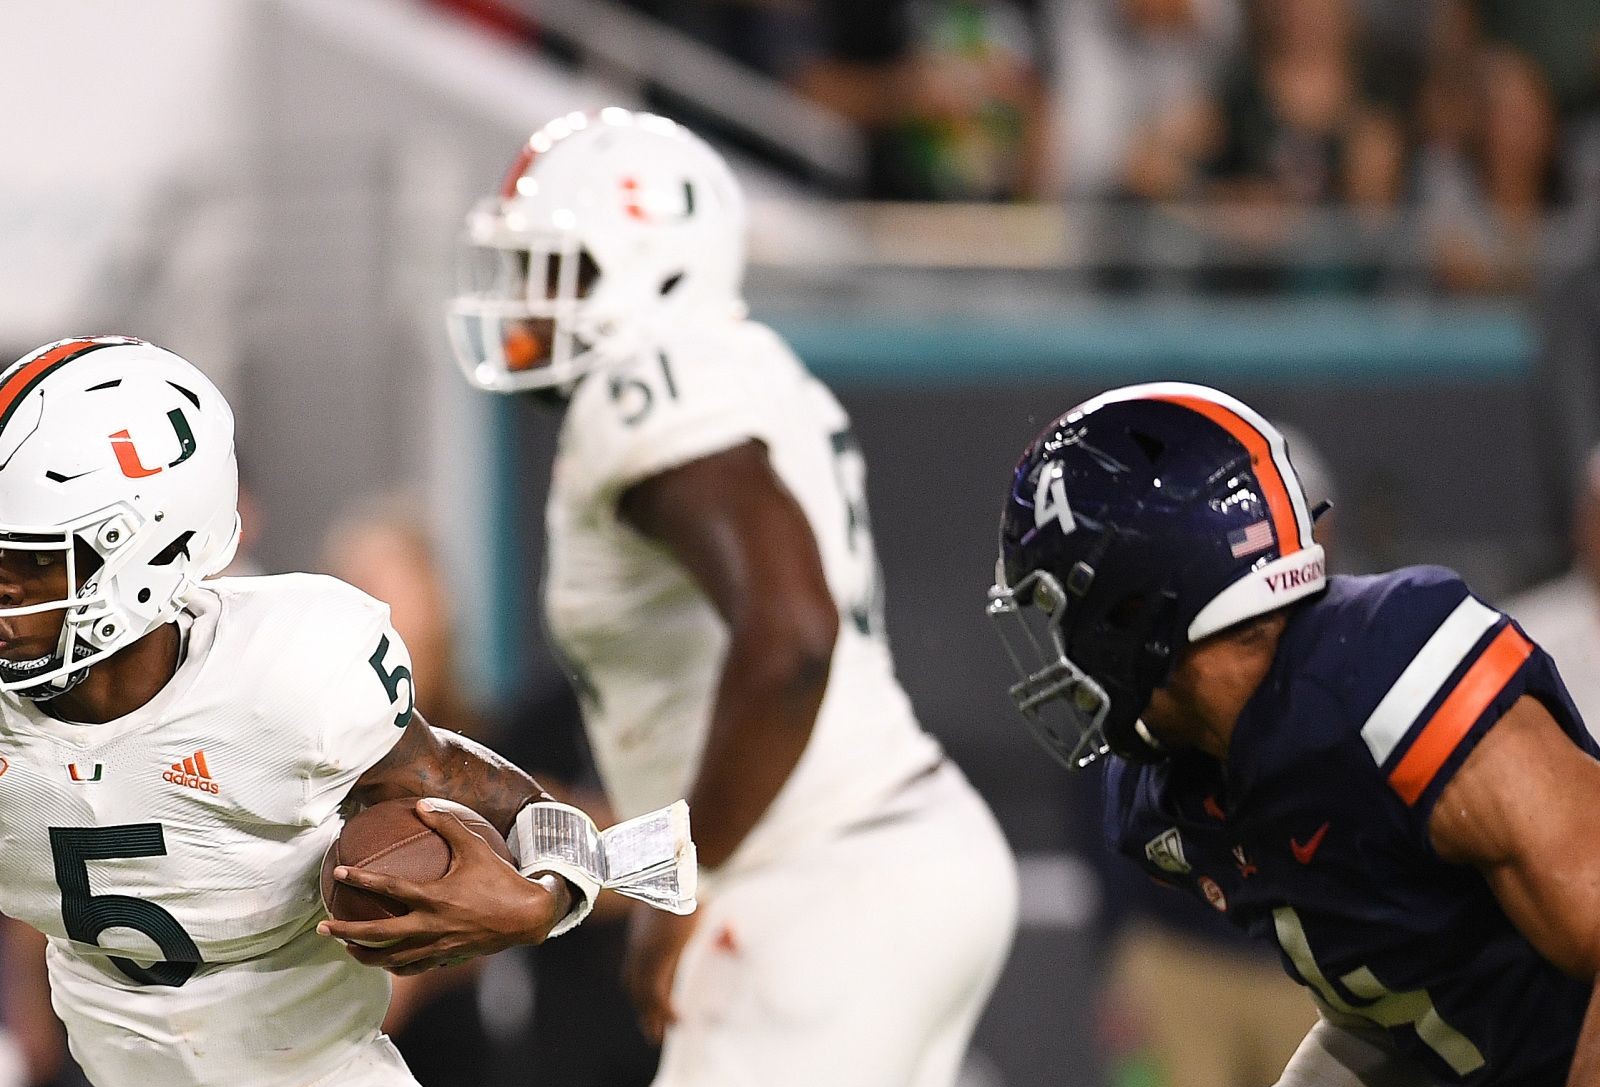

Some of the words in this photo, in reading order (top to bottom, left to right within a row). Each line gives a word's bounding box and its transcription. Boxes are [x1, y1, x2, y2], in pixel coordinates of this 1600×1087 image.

[607, 349, 679, 426] 51
[108, 407, 196, 478] U
[368, 632, 413, 729] 5
[67, 763, 102, 781] U
[162, 769, 219, 795] adidas
[48, 822, 204, 988] 5
